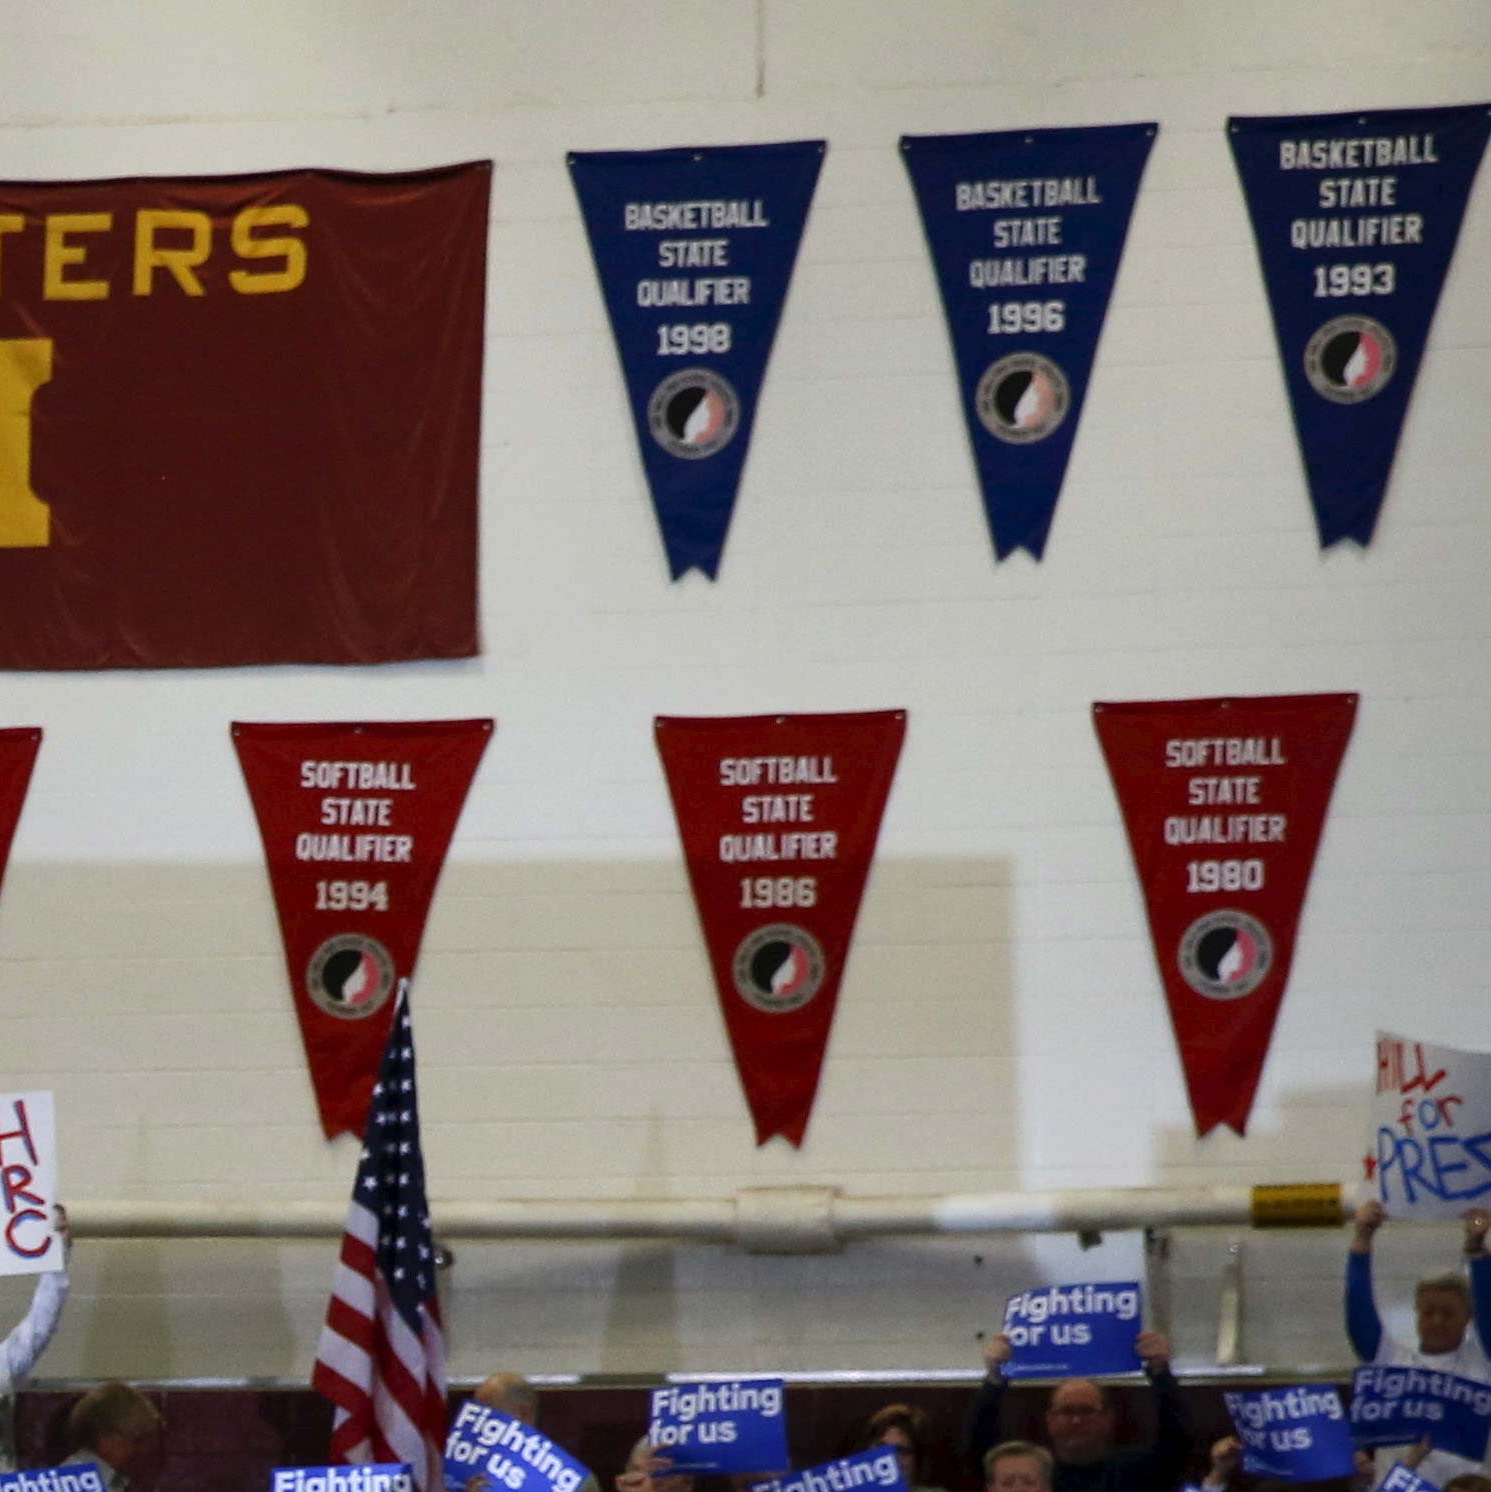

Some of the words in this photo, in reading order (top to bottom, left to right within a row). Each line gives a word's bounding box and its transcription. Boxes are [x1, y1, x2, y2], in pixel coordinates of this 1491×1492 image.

[1280, 135, 1437, 169] BASKETBALL
[956, 178, 1100, 210] BASKETBALL
[1320, 178, 1395, 208] STATE
[625, 201, 768, 230] BASKETBALL
[994, 217, 1061, 248] STATE
[1291, 214, 1422, 249] QUALIFIER
[659, 239, 728, 267] STATE
[970, 255, 1086, 288] QUALIFIER
[1315, 264, 1394, 297] 1993
[637, 278, 750, 307] QUALIFIER
[988, 301, 1064, 333] 1996
[658, 323, 730, 355] 1998
[1166, 738, 1285, 767] SOFTBALL
[301, 761, 415, 789] SOFTBALL
[720, 756, 837, 785] SOFTBALL
[1189, 776, 1260, 805] STATE
[321, 797, 392, 826] STATE
[743, 794, 813, 823] STATE
[1165, 814, 1286, 845] QUALIFIER
[296, 833, 412, 862] QUALIFIER
[720, 831, 837, 862] QUALIFIER
[1188, 859, 1264, 892] 1980
[316, 881, 388, 910] 1994
[741, 877, 816, 908] 1986
[1398, 1095, 1462, 1136] for
